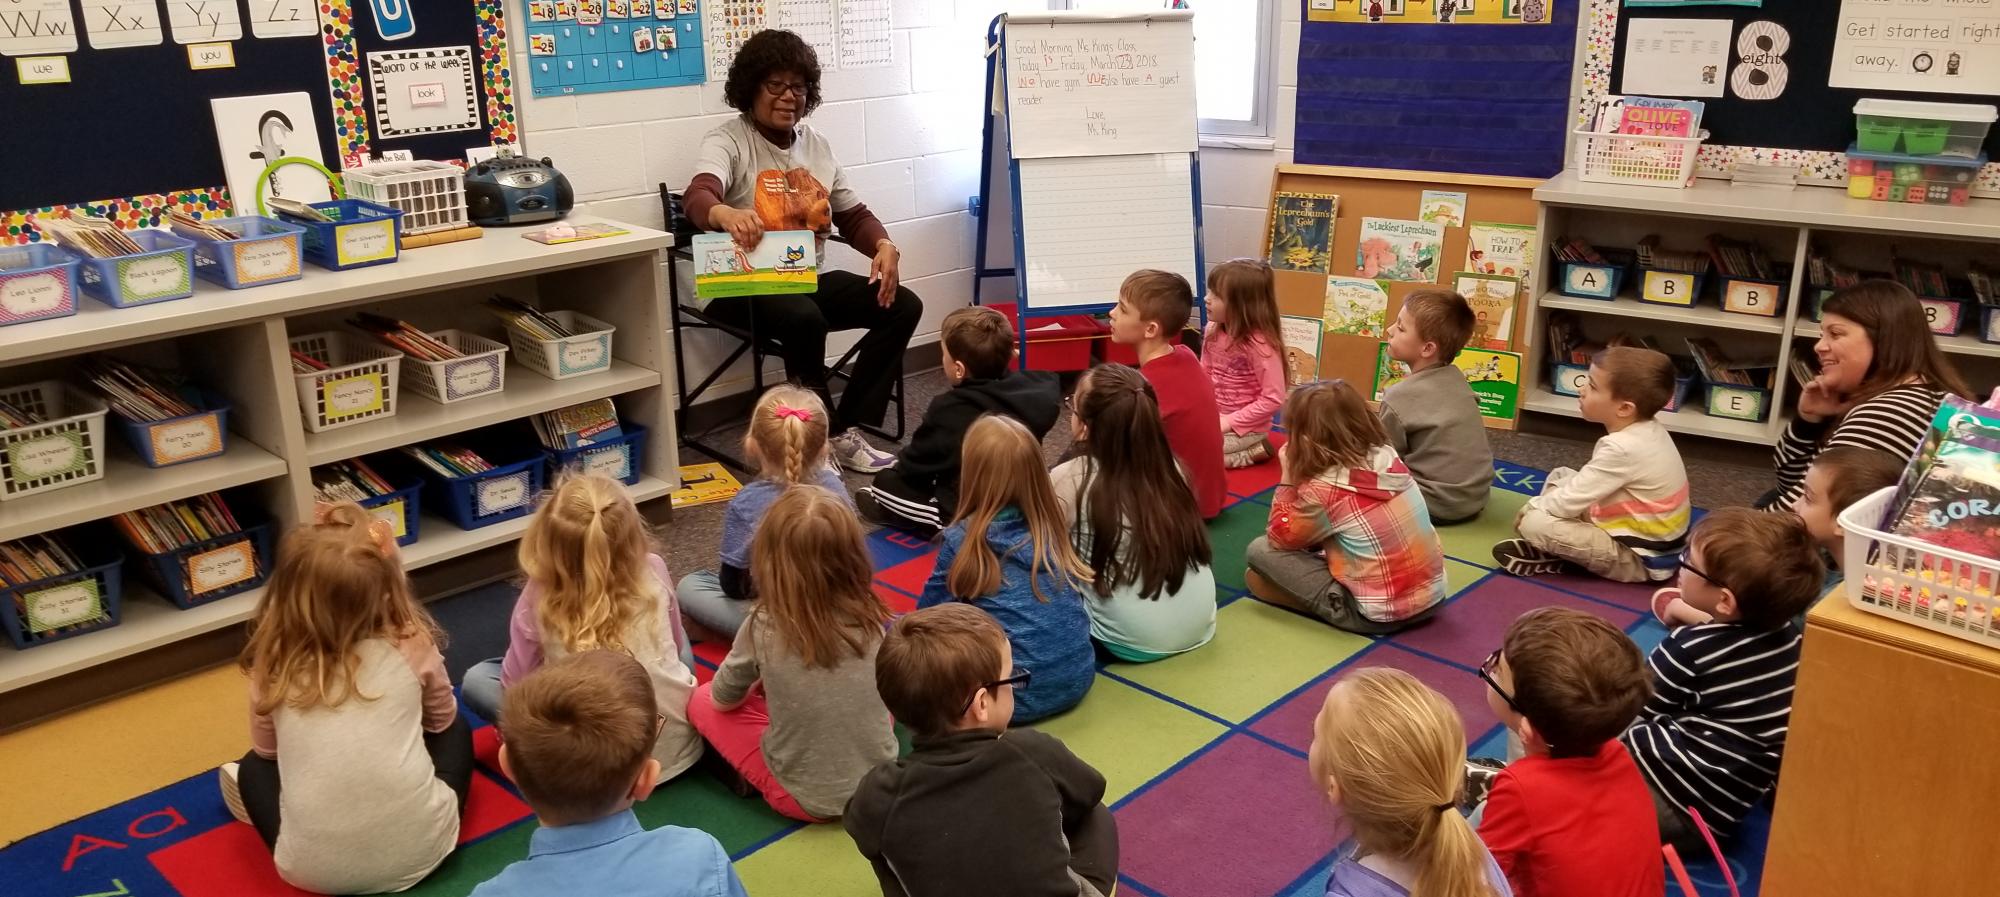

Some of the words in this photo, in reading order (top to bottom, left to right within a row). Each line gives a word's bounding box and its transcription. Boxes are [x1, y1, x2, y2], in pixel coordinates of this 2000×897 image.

[713, 13, 724, 21] 60
[1847, 22, 1877, 37] Get
[1887, 24, 1950, 39] started
[1963, 23, 2000, 42] right
[715, 36, 725, 44] 70
[1015, 40, 1036, 54] Good
[201, 51, 221, 63] you
[716, 58, 727, 66] 80
[1742, 53, 1781, 66] eight
[1855, 54, 1899, 71] away.
[33, 64, 53, 73] we
[1016, 57, 1039, 75] Today
[417, 88, 435, 98] look
[1627, 108, 1682, 125] OLIVE
[1648, 122, 1679, 132] LOVE
[1279, 206, 1330, 218] Leprechaun's
[1400, 224, 1437, 237] Leprechaun
[1581, 271, 1597, 287] A
[1663, 279, 1675, 295] B
[1746, 290, 1759, 306] B
[1925, 306, 1937, 323] B
[1731, 396, 1743, 411] E
